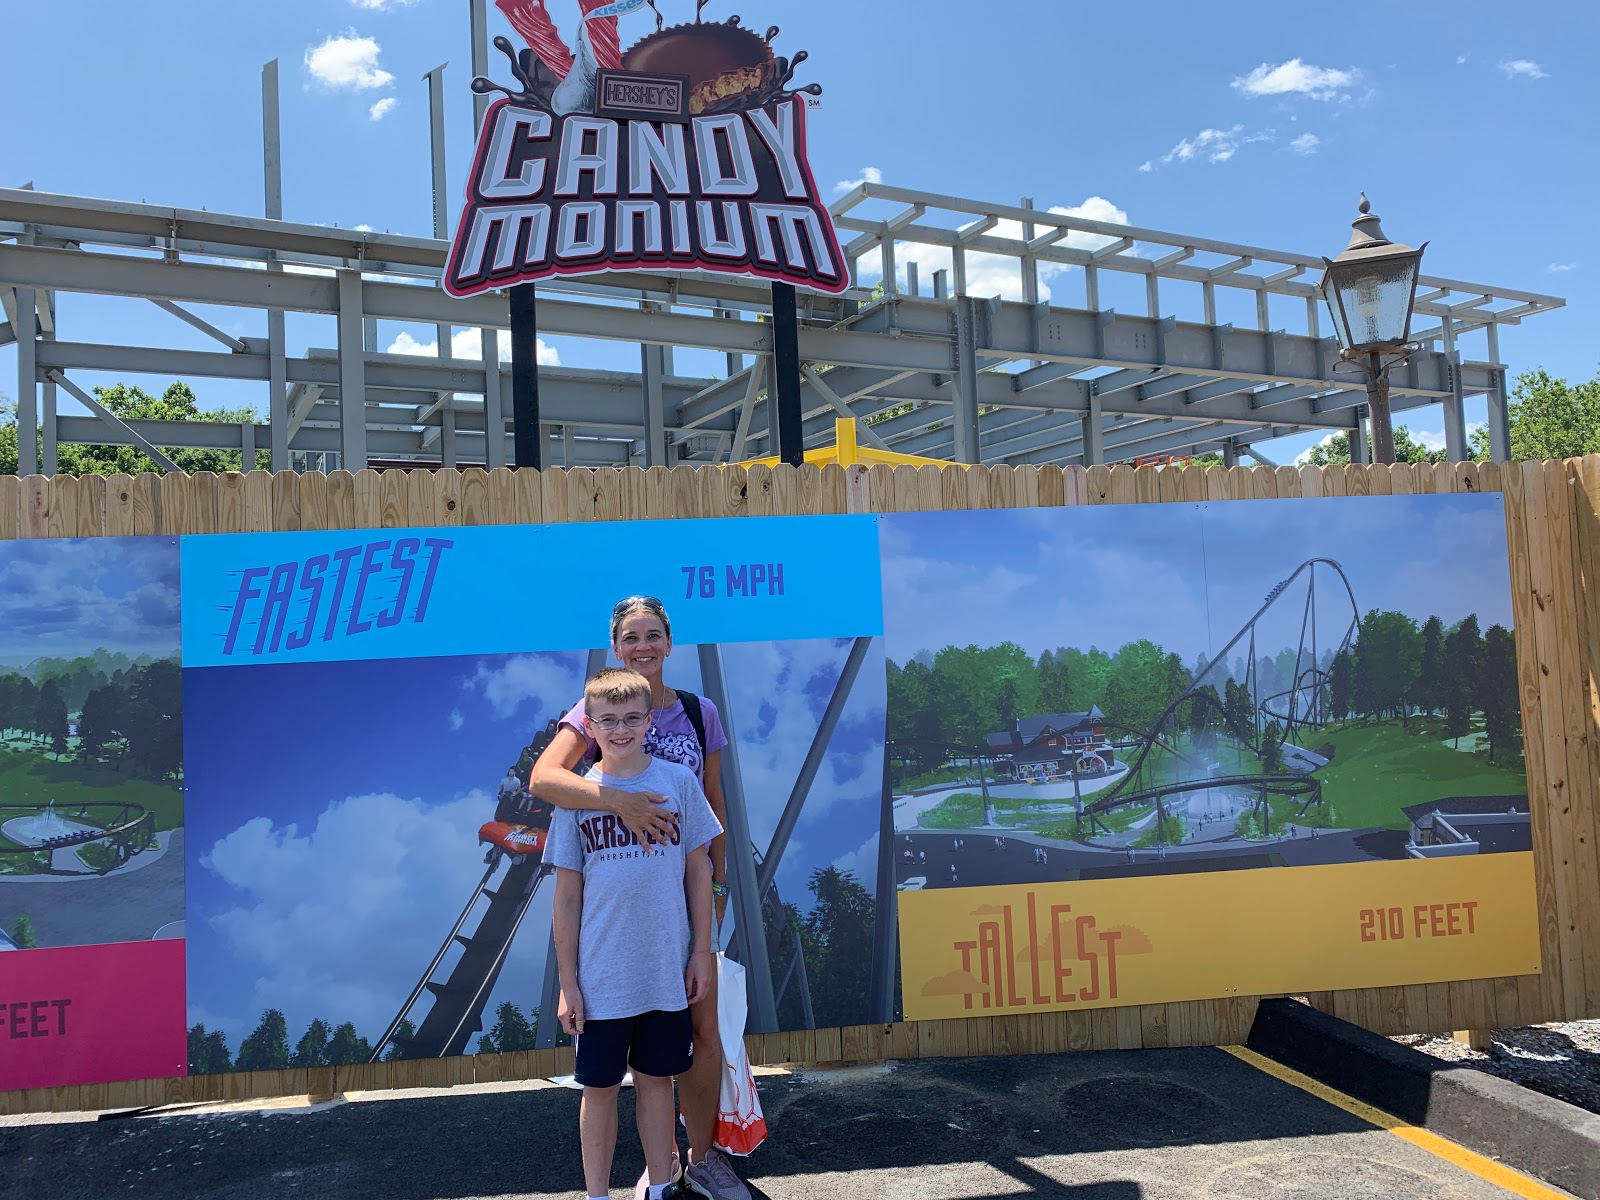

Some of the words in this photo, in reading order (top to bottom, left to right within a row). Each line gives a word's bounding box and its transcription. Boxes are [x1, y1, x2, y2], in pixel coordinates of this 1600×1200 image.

[607, 82, 677, 107] HERSHEY'S
[477, 100, 810, 200] CANDY
[456, 200, 839, 284] MONIUM
[221, 537, 455, 656] FASTEST
[681, 565, 715, 599] 76
[726, 563, 785, 598] MPH
[580, 812, 681, 854] HERSS
[600, 850, 650, 862] HERSHEY,
[654, 849, 665, 857] PA
[1360, 907, 1405, 942] 210
[1413, 901, 1478, 938] FEET
[953, 891, 1122, 1010] TALLEST
